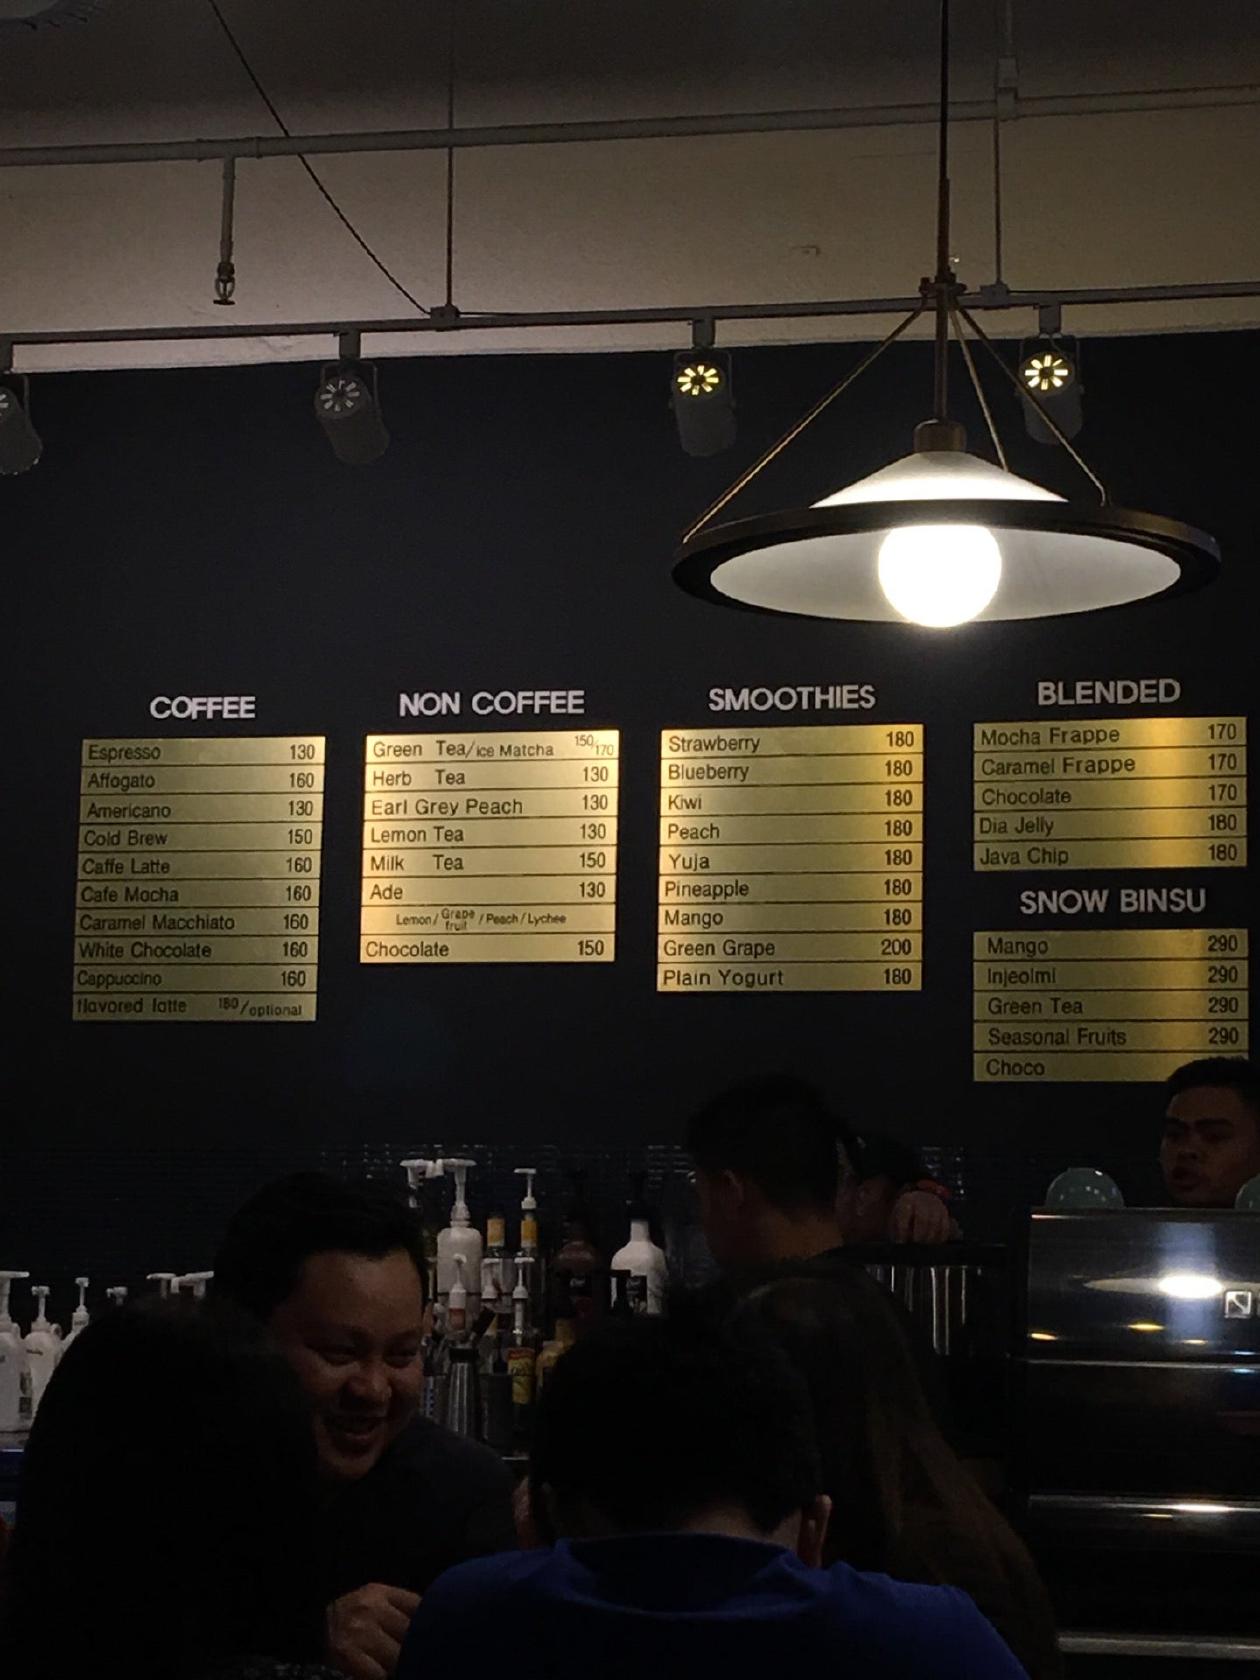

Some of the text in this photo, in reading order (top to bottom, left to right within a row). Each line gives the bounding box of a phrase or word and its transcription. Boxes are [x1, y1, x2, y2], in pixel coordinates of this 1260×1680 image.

[708, 684, 876, 712] SMOOTHIES
[1038, 678, 1181, 706] BLENDED
[150, 696, 256, 720] COFFEE
[400, 690, 585, 718] NON COFFEE
[669, 731, 914, 754] Strawberry 180
[981, 723, 1237, 746] Mocha Frappe 170
[88, 744, 315, 763] Espresso 130
[373, 741, 423, 757] Green
[499, 744, 554, 757] Matcha
[669, 760, 913, 782] Blueberry 180
[981, 753, 1237, 776] Caramel Frappe 170
[87, 772, 315, 792] Affogato 160
[372, 766, 609, 786] Herb Tea 130
[372, 794, 608, 816] Earl Grey Peach 130
[668, 790, 913, 810] Kiwi 180
[981, 784, 1238, 806] Chocolate 170
[86, 801, 314, 818] Americano 130
[371, 823, 606, 843] Lemon Tea 130
[668, 820, 913, 840] Peach 180
[980, 813, 1237, 837] Dia Jelly 180
[84, 829, 313, 846] Cold Brew 150
[371, 852, 606, 871] Milk Tea 150
[669, 849, 912, 872] Yuja 180
[980, 843, 1238, 867] Java Chip 180
[82, 857, 312, 875] Caffe Latte 160
[81, 885, 312, 903] Cafe Mocha 160
[370, 882, 605, 900] Ade 130
[665, 878, 912, 899] Pineapple 180
[1019, 887, 1207, 915] SNOW BINSU
[80, 914, 309, 931] Caramel Macchiato 160
[664, 908, 912, 929] Mango 180
[80, 941, 308, 958] White Chocolate 160
[365, 940, 605, 958] Chocolate 150
[663, 938, 912, 959] Green Grape 200
[987, 934, 1238, 958] Mango 290
[77, 970, 307, 990] Cappuccino 160
[663, 968, 912, 989] Plain Yogurt 180
[988, 965, 1238, 987] Injeolmi 290
[988, 996, 1239, 1014] Green Tea 290
[988, 1027, 1239, 1046] Seasonal Fruits 290
[986, 1058, 1045, 1077] Choco
